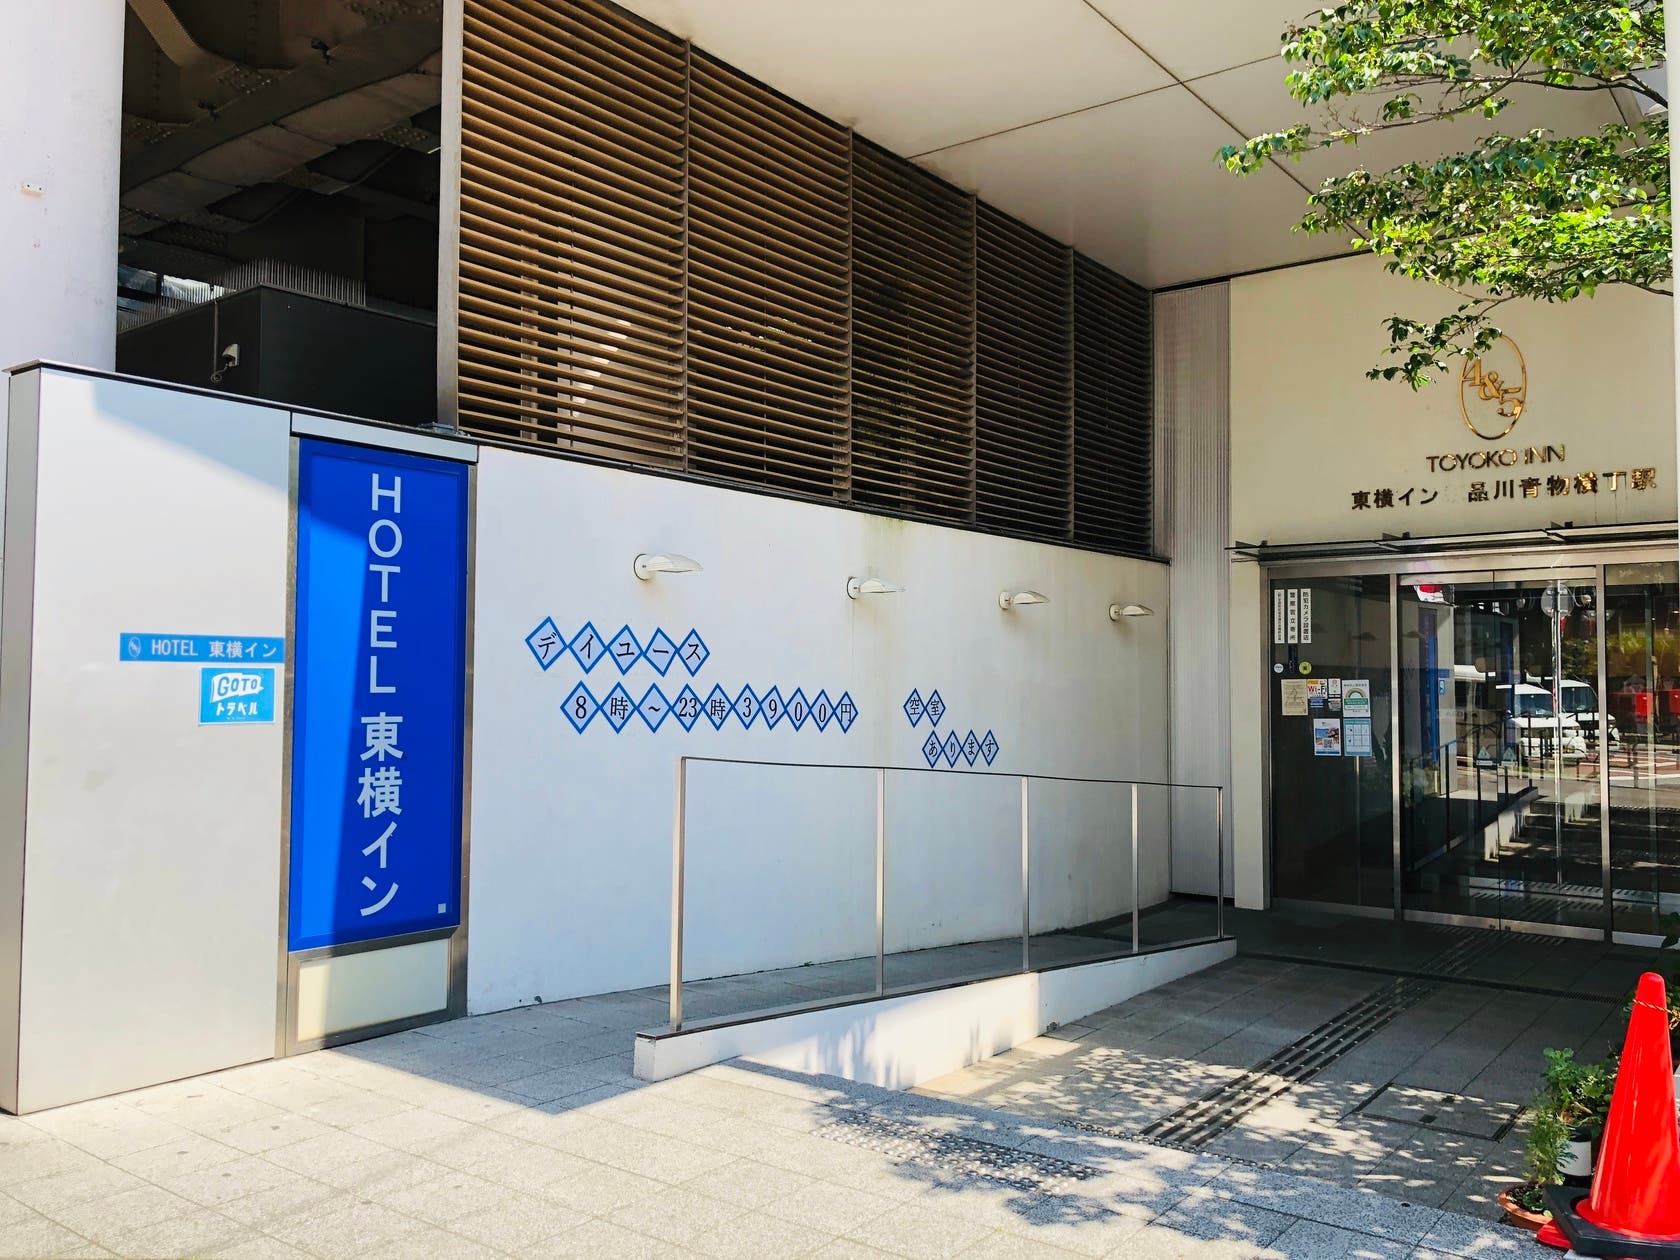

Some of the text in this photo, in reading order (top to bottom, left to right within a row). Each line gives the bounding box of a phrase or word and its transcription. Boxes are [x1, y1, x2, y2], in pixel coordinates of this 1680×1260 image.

[1426, 444, 1566, 473] TOYOKO INN
[1351, 467, 1658, 511] 東横イン 品川青物横丁駅
[151, 639, 277, 658] HOTEL 東横イン
[216, 702, 258, 716] トラベル
[357, 473, 404, 917] HOTEL 東横イン
